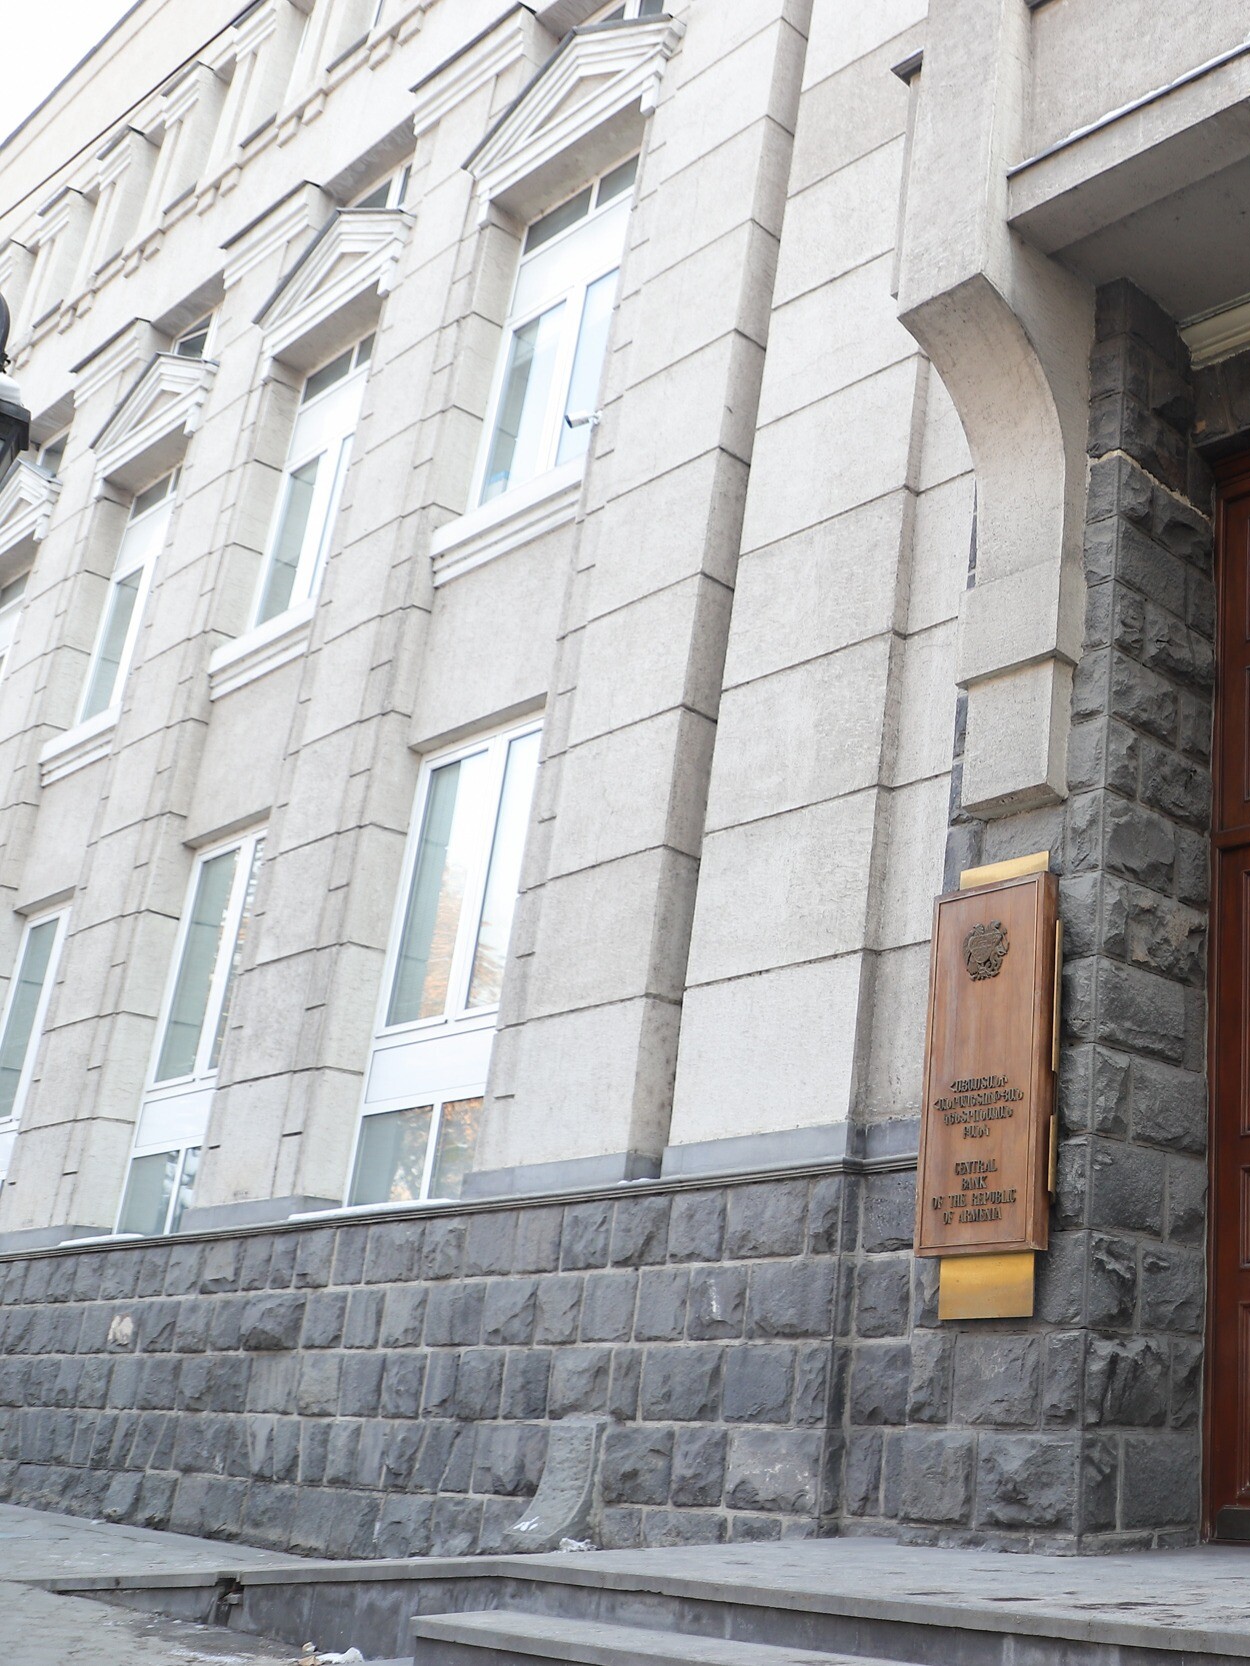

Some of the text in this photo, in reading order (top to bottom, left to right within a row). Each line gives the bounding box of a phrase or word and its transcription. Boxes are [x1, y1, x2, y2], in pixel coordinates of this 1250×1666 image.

[955, 1159, 998, 1175] CENTRAL
[961, 1176, 988, 1190] BANK
[932, 1189, 1016, 1210] OF THE REPUBLIC
[943, 1207, 1002, 1225] OF ARMENIA
